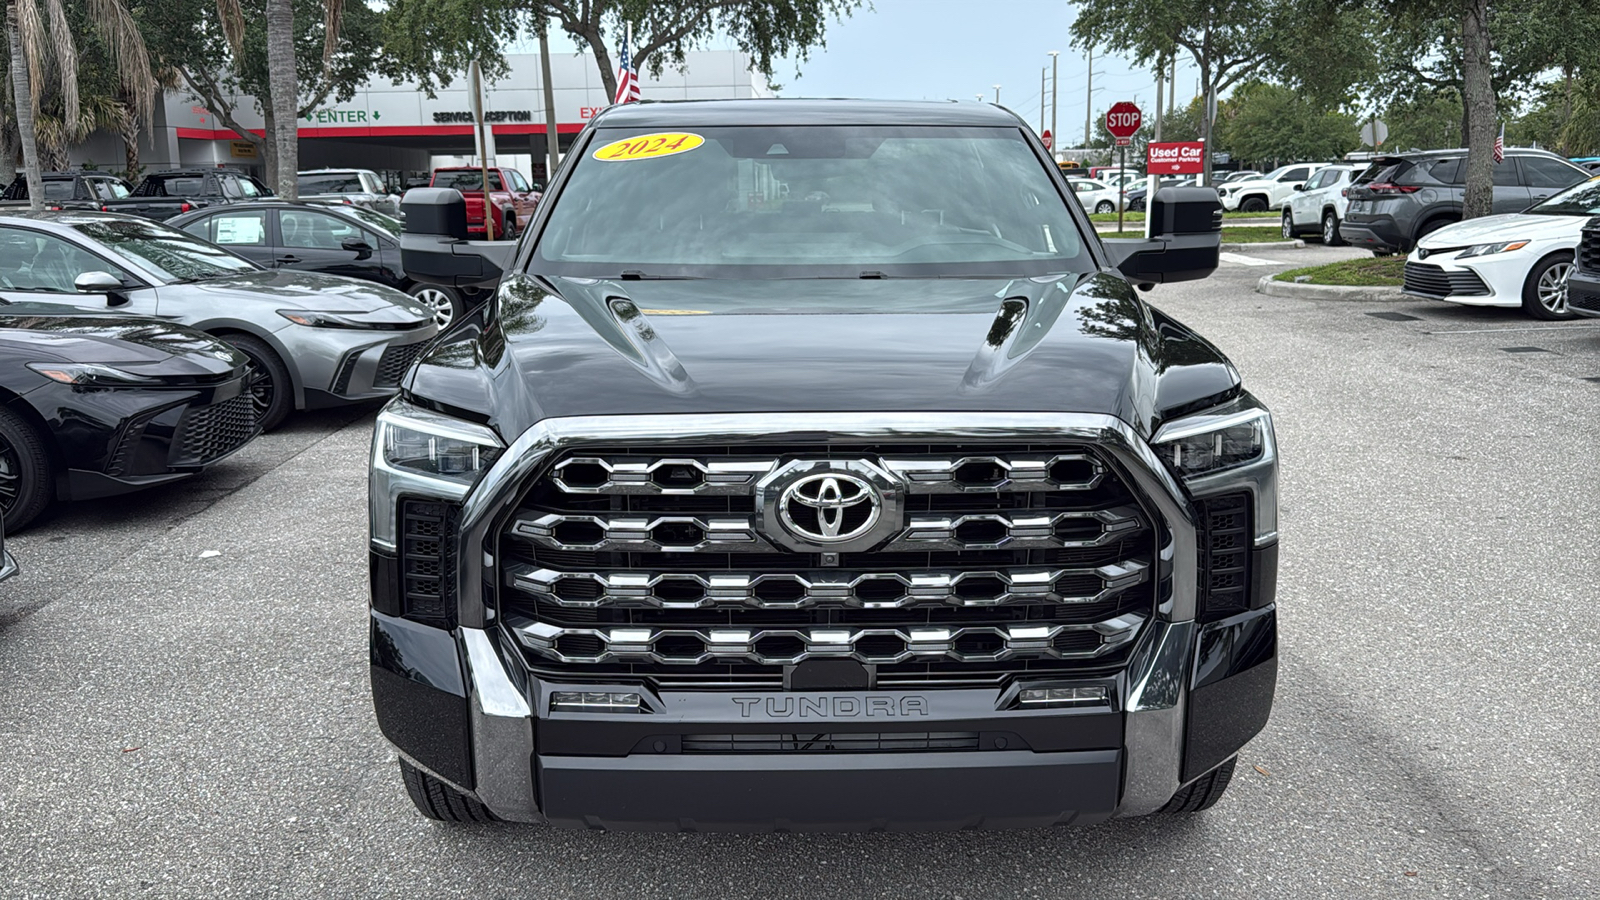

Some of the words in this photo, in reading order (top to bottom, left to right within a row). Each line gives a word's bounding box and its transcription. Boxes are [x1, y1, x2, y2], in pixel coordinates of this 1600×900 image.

[317, 110, 367, 123] ENTER
[433, 111, 474, 123] SERVICE
[484, 110, 531, 122] ECEPTION
[580, 107, 604, 119] EX
[1108, 112, 1139, 127] STOP
[608, 135, 689, 158] 2024
[1150, 147, 1178, 157] Used
[1181, 146, 1202, 157] Car
[1178, 156, 1200, 164] Parking
[732, 696, 928, 718] TUNDRA
